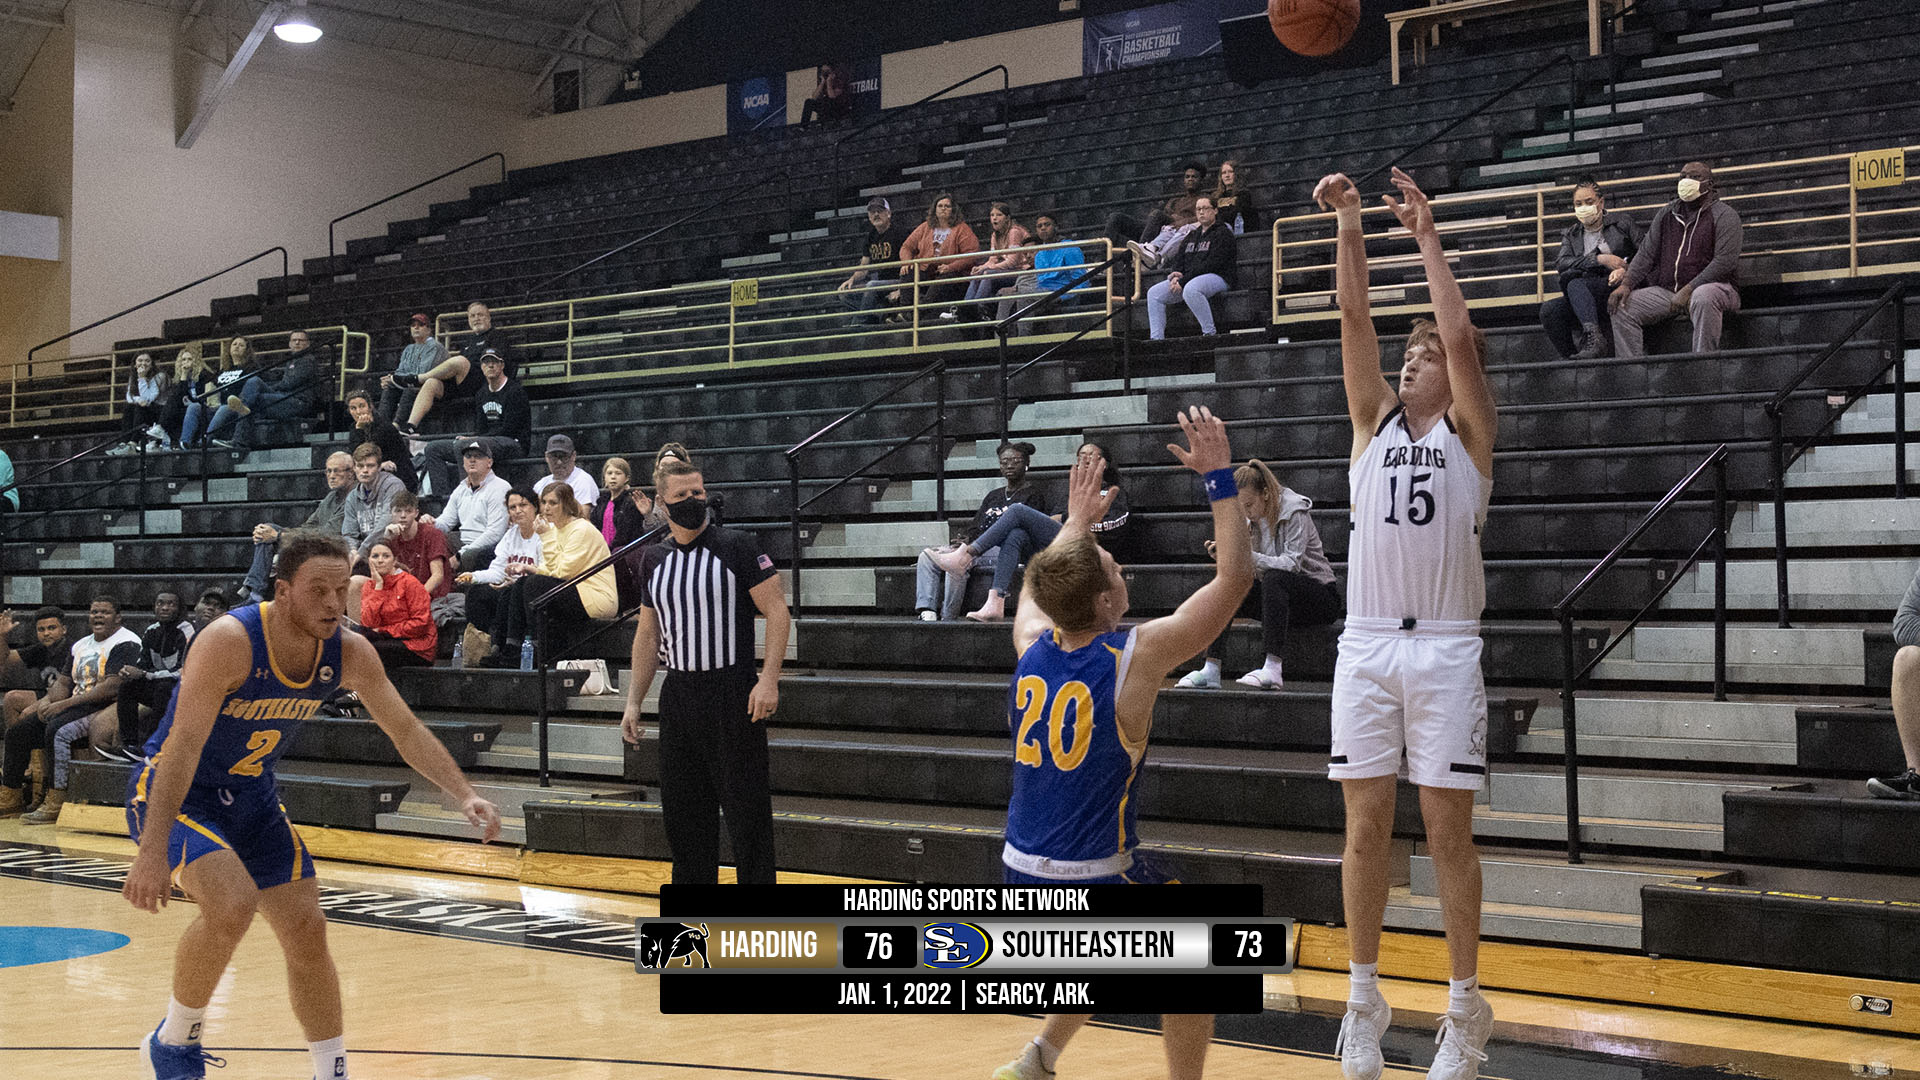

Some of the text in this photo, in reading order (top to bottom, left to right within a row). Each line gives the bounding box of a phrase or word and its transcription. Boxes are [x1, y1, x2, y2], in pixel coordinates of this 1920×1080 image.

[1124, 32, 1181, 54] BASKETBALL
[1122, 47, 1171, 64] CHAMPIONSHIP
[743, 93, 770, 109] NCAA
[1857, 156, 1902, 182] HOME
[734, 283, 757, 301] HOME
[1384, 472, 1436, 526] 15
[1015, 675, 1096, 771] 20
[228, 730, 281, 777] 2
